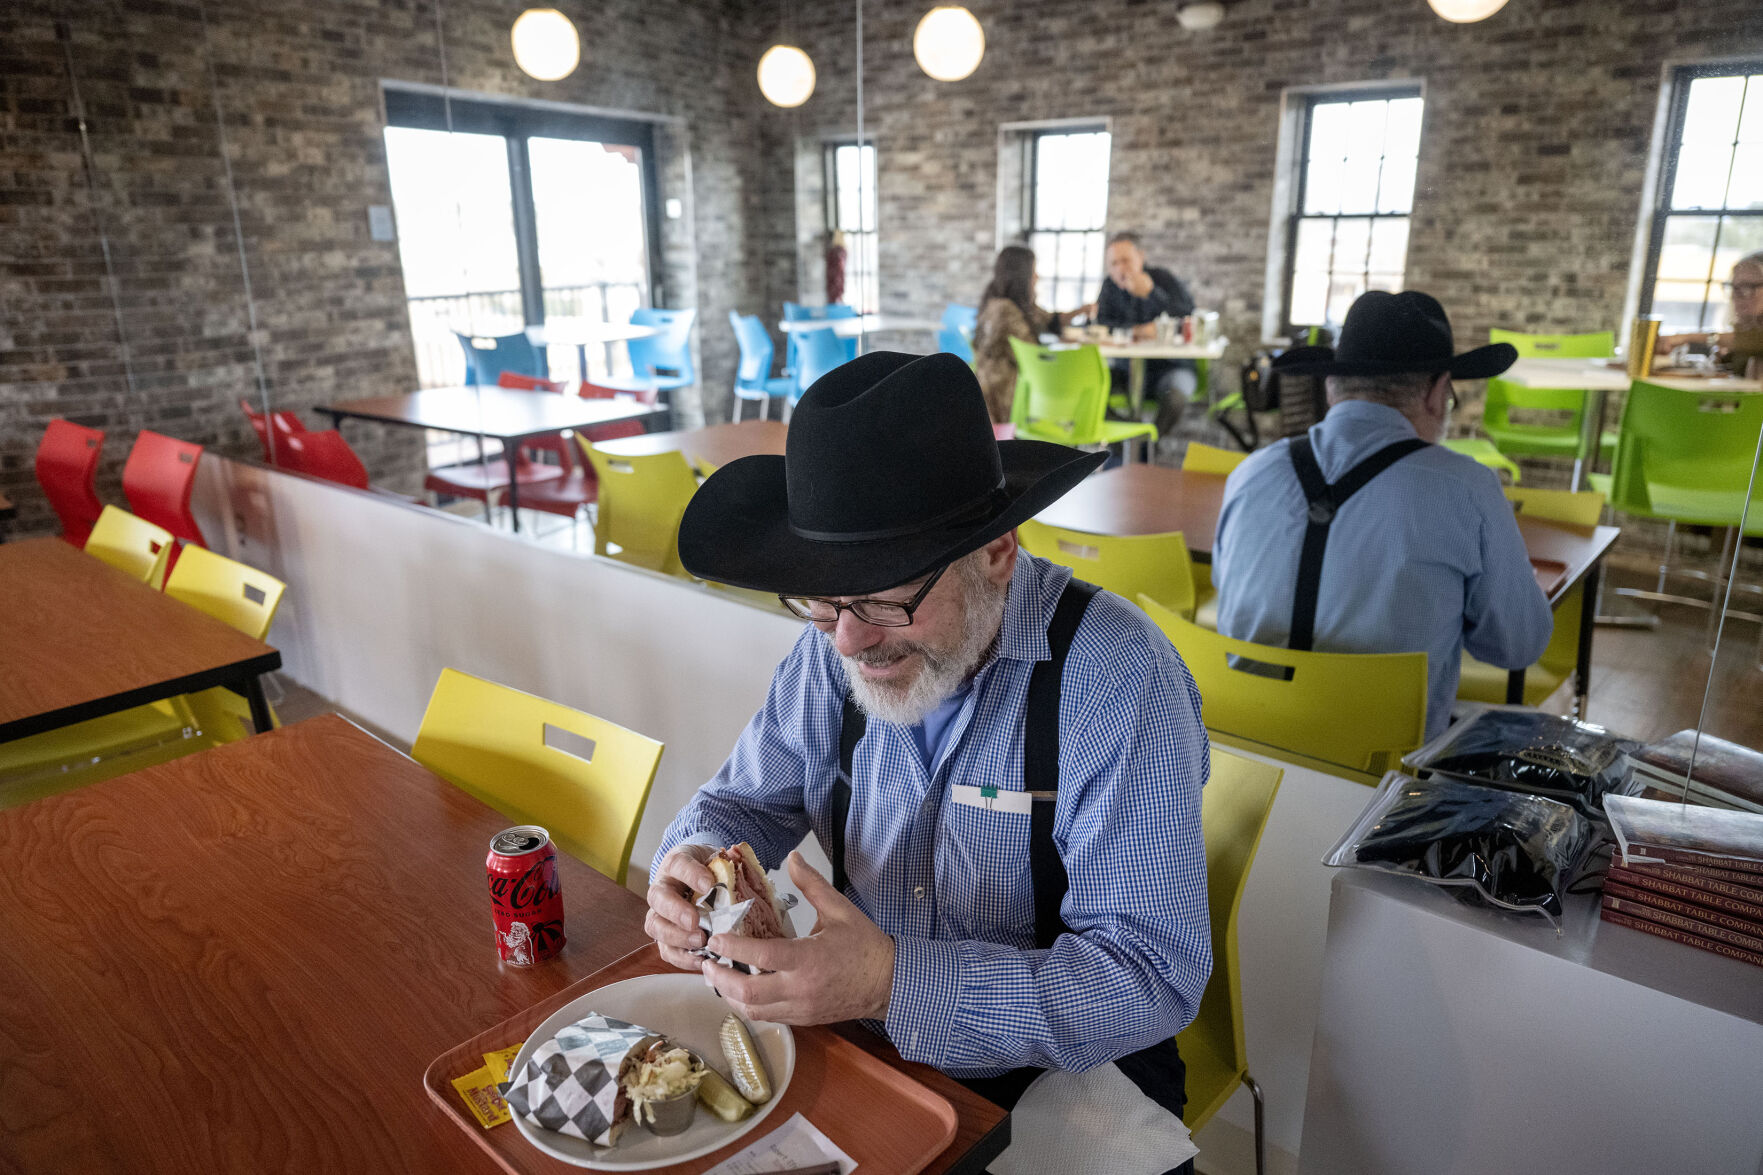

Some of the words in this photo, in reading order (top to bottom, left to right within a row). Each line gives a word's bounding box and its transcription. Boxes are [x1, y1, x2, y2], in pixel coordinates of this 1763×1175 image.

[1697, 856, 1732, 868] SHABBAT
[1735, 861, 1759, 871] TABLE
[1731, 872, 1756, 883] TABLE
[1663, 869, 1706, 888] SHABBAT
[1707, 880, 1737, 896] TABLE
[1638, 893, 1683, 912] SHABBAT
[1685, 906, 1717, 922] TABLE
[1642, 878, 1688, 897] SHABBAT
[1690, 891, 1722, 906] TABLE
[1724, 900, 1763, 917] COMPA
[1634, 921, 1680, 941] SHABBAT
[1682, 934, 1713, 950] TABLE
[1652, 911, 1695, 930] SHABBAT
[1697, 924, 1727, 939] TABLE
